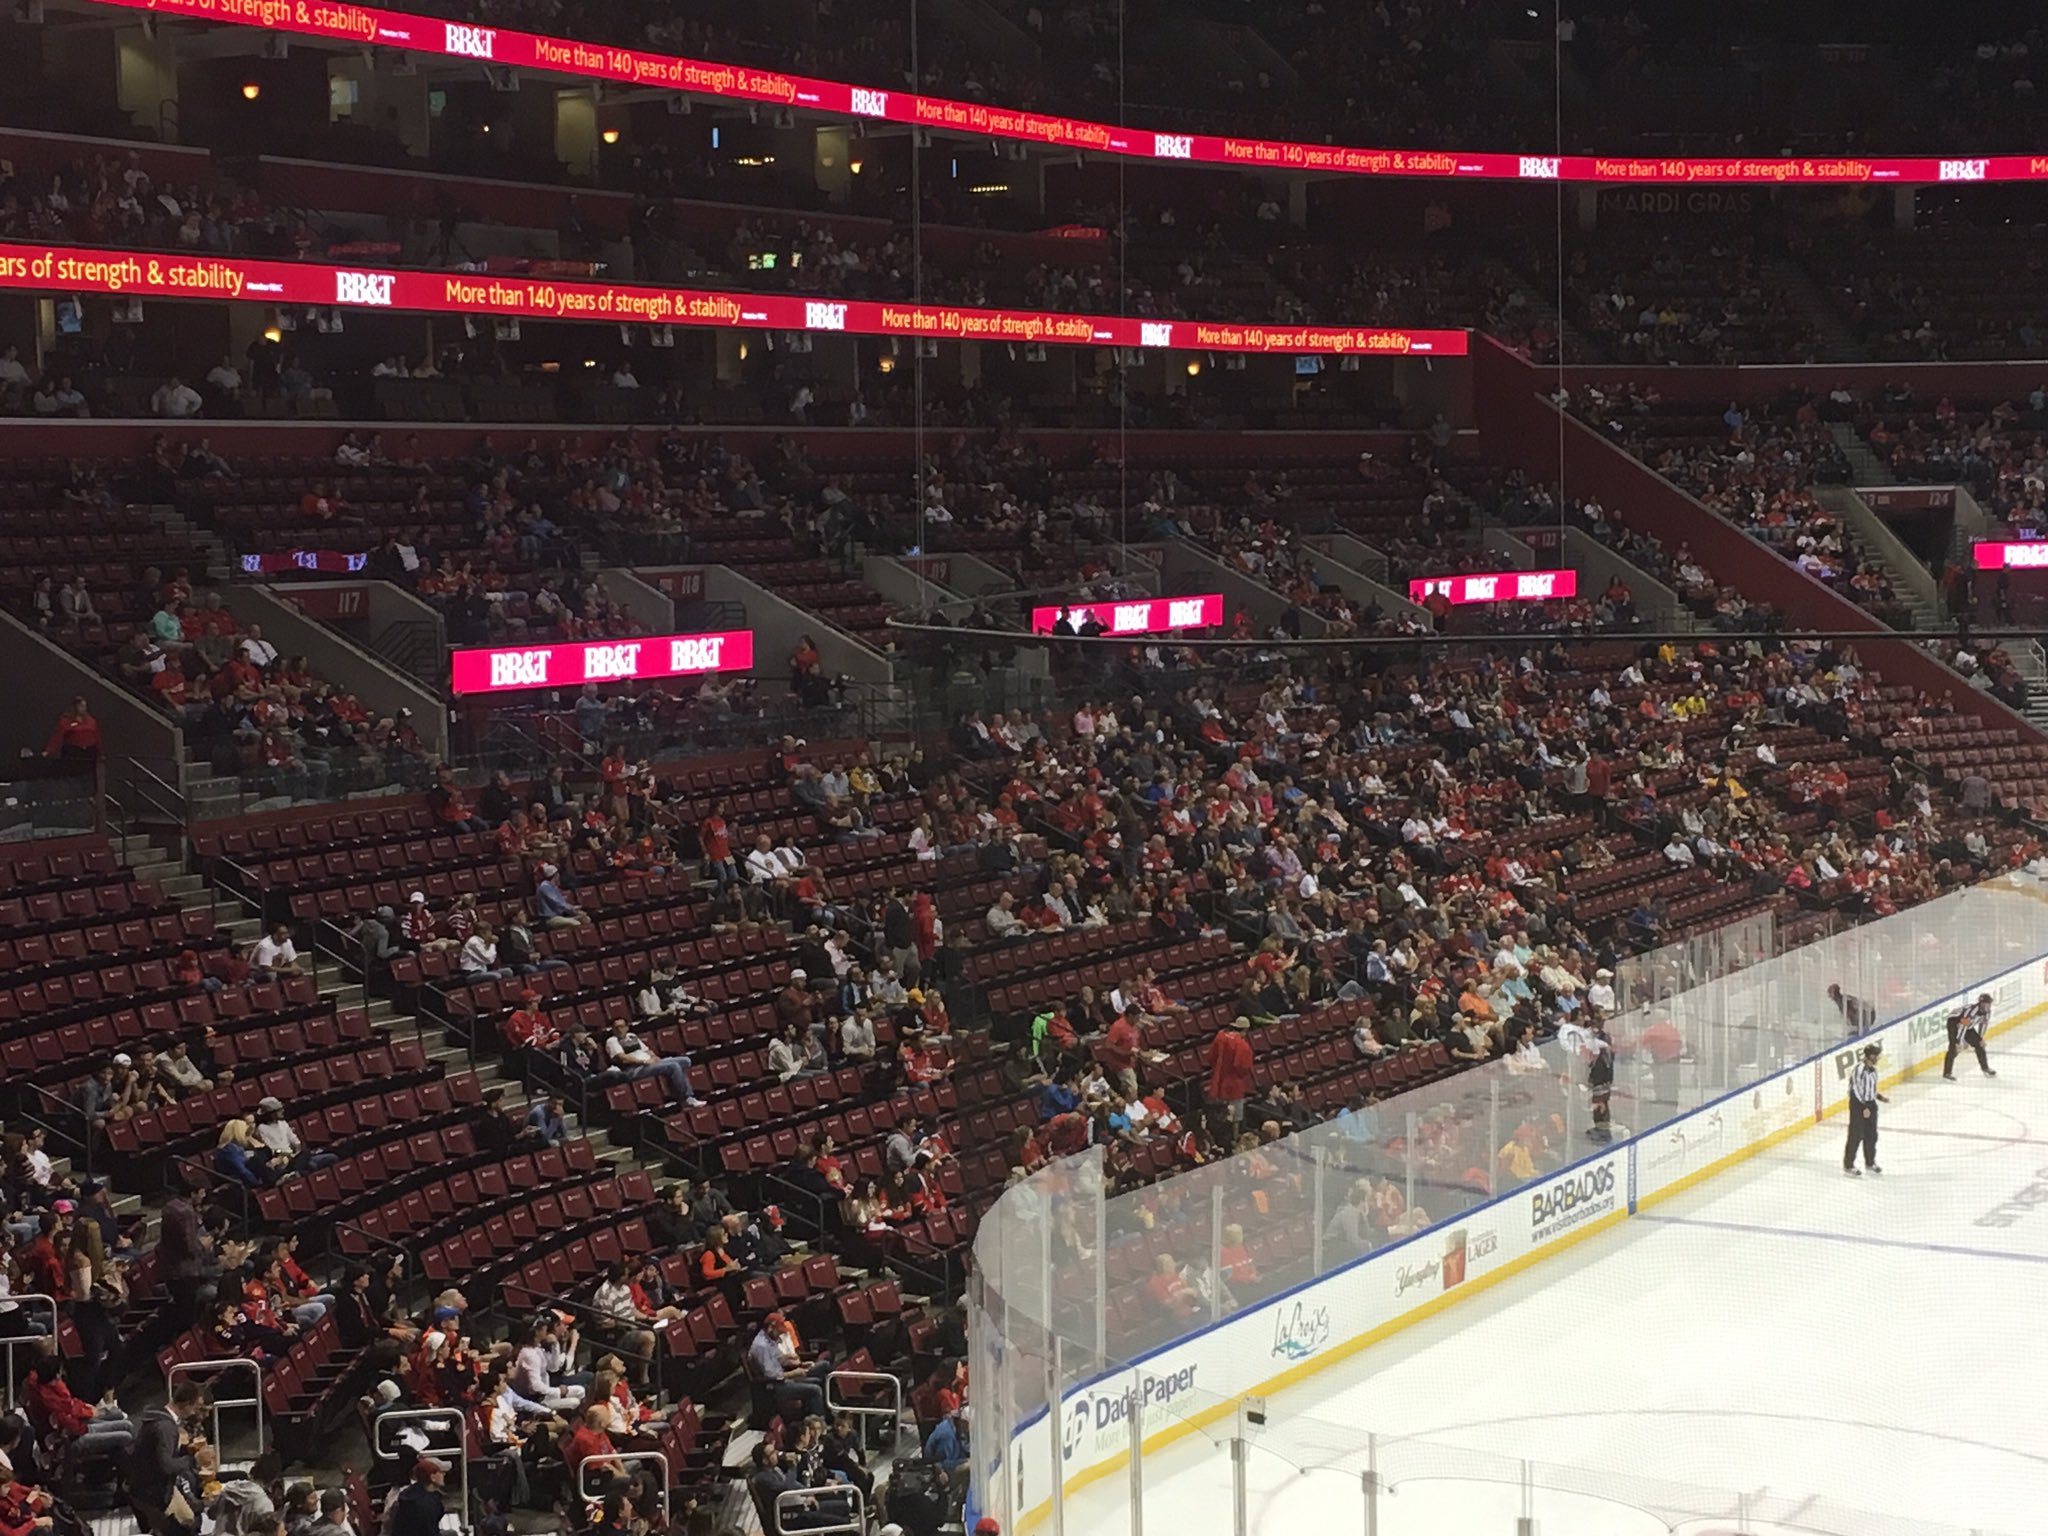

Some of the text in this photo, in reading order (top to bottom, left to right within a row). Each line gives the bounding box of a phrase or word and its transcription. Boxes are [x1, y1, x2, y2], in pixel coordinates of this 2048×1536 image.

[221, 0, 291, 25] strength
[296, 4, 310, 25] &
[314, 8, 378, 40] stability
[445, 24, 496, 58] BB&T
[535, 39, 571, 65] More
[574, 46, 604, 70] than
[607, 51, 632, 74] 140
[633, 60, 667, 80] years
[669, 60, 683, 80] of
[685, 64, 735, 93] strength
[737, 72, 749, 92] &
[750, 74, 796, 104] stability
[851, 88, 888, 117] BB&T
[916, 100, 1110, 149] More than 140 years of strength & stability
[1154, 134, 1194, 158] BB&T
[1224, 140, 1458, 175] More than 140 years of strength & stability
[1518, 157, 1562, 178] BB&T
[1595, 160, 1626, 177] More
[1628, 160, 1657, 177] than
[1660, 162, 1685, 177] 140
[1688, 165, 1723, 181] years
[1726, 161, 1742, 176] of
[1743, 161, 1800, 181] strength
[1802, 161, 1815, 177] &
[1818, 161, 1872, 181] stability
[1938, 160, 1990, 180] BB&T
[1602, 192, 1753, 213] MARDI GRAS
[31, 252, 53, 278] of
[58, 258, 142, 289] strength
[147, 260, 164, 285] &
[168, 262, 244, 296] stability
[336, 272, 395, 305] BB&T
[446, 280, 741, 324] More than 140 years of strength & stability
[805, 302, 848, 330] BB&T
[882, 308, 1094, 342] More than 140 years of strength & stability
[1140, 322, 1172, 347] BB&T
[1197, 327, 1220, 344] More
[1221, 328, 1242, 345] than
[1244, 330, 1262, 346] 140
[1264, 334, 1293, 351] years
[1294, 330, 1307, 347] of
[1308, 332, 1354, 352] strength
[1356, 332, 1366, 348] &
[1368, 332, 1410, 354] stability
[681, 575, 700, 595] 118
[1465, 577, 1498, 600] BB&T
[1518, 574, 1555, 596] BB&T
[338, 592, 360, 614] 117
[1169, 599, 1204, 626] BB&T
[1114, 604, 1151, 632] BB&T
[490, 650, 551, 686] BB&T
[584, 644, 641, 679] BB&T
[670, 637, 724, 672] BB&T
[1532, 1161, 1614, 1227] BARBADOS
[1468, 1235, 1498, 1262] LAGER
